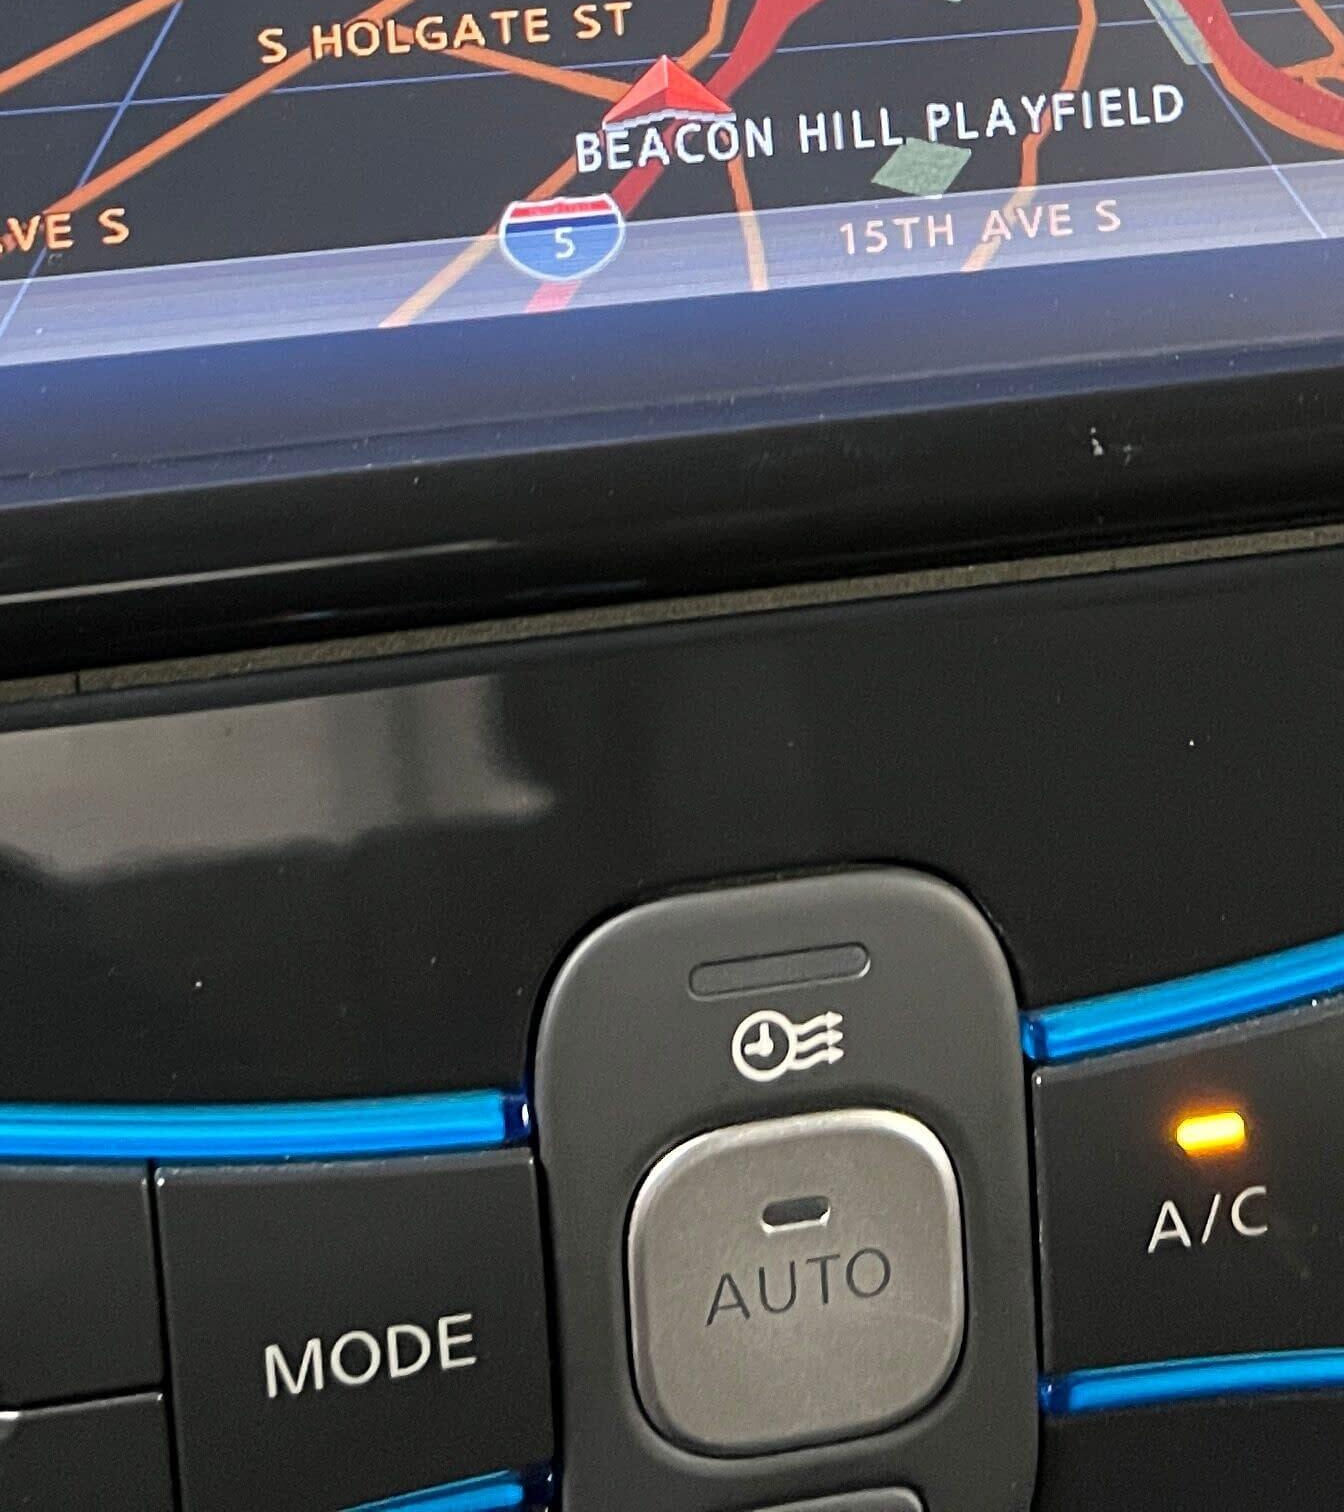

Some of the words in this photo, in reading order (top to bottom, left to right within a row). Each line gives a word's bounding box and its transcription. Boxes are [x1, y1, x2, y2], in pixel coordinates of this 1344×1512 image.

[258, 28, 288, 64] S
[312, 7, 550, 60] HOLGATE
[573, 1, 632, 39] ST
[575, 116, 774, 174] BEACON
[798, 108, 905, 154] HILL
[927, 83, 1184, 142] PLAYFIELD
[98, 207, 130, 245] S
[555, 226, 576, 259] 5
[839, 213, 955, 256] 15TH
[981, 206, 1072, 243] AVE
[1098, 199, 1122, 233] S
[1147, 1185, 1268, 1254] A/C
[705, 1247, 892, 1327] AUTO
[264, 1312, 477, 1399] MODE
